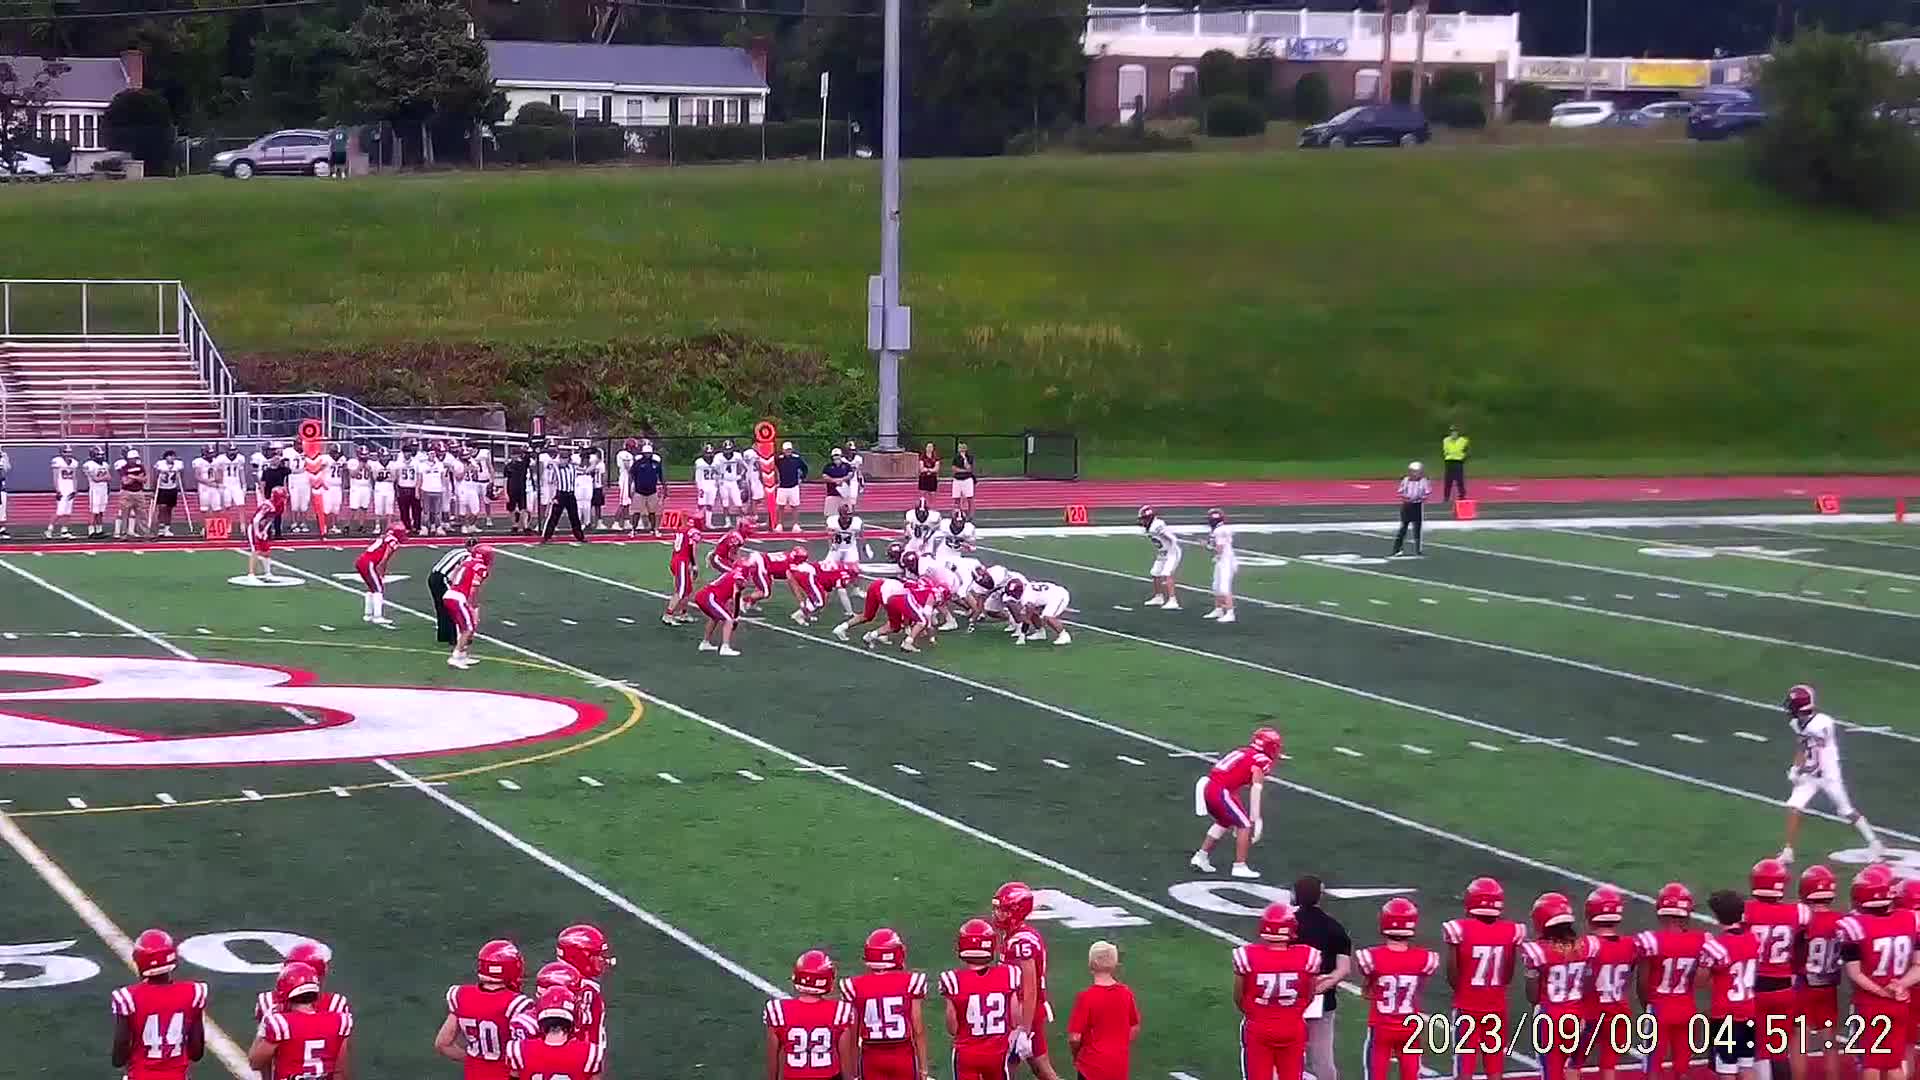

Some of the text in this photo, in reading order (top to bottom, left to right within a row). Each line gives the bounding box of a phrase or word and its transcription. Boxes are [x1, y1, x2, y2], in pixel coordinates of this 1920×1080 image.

[206, 522, 227, 537] 40
[662, 511, 680, 529] 30
[1071, 506, 1085, 522] 20
[1014, 941, 1034, 959] 15
[1751, 924, 1793, 964] 72
[1872, 935, 1912, 977] 78
[1471, 945, 1504, 986] 71
[1547, 961, 1587, 1002] 87
[1656, 957, 1697, 994] 17
[1255, 971, 1300, 1006] 75
[1376, 974, 1419, 1014] 37
[863, 995, 907, 1040] 45
[965, 991, 1006, 1037] 42
[141, 1011, 186, 1059] 44
[458, 1016, 501, 1061] 50
[786, 1026, 834, 1068] 32
[302, 1038, 326, 1079] 5
